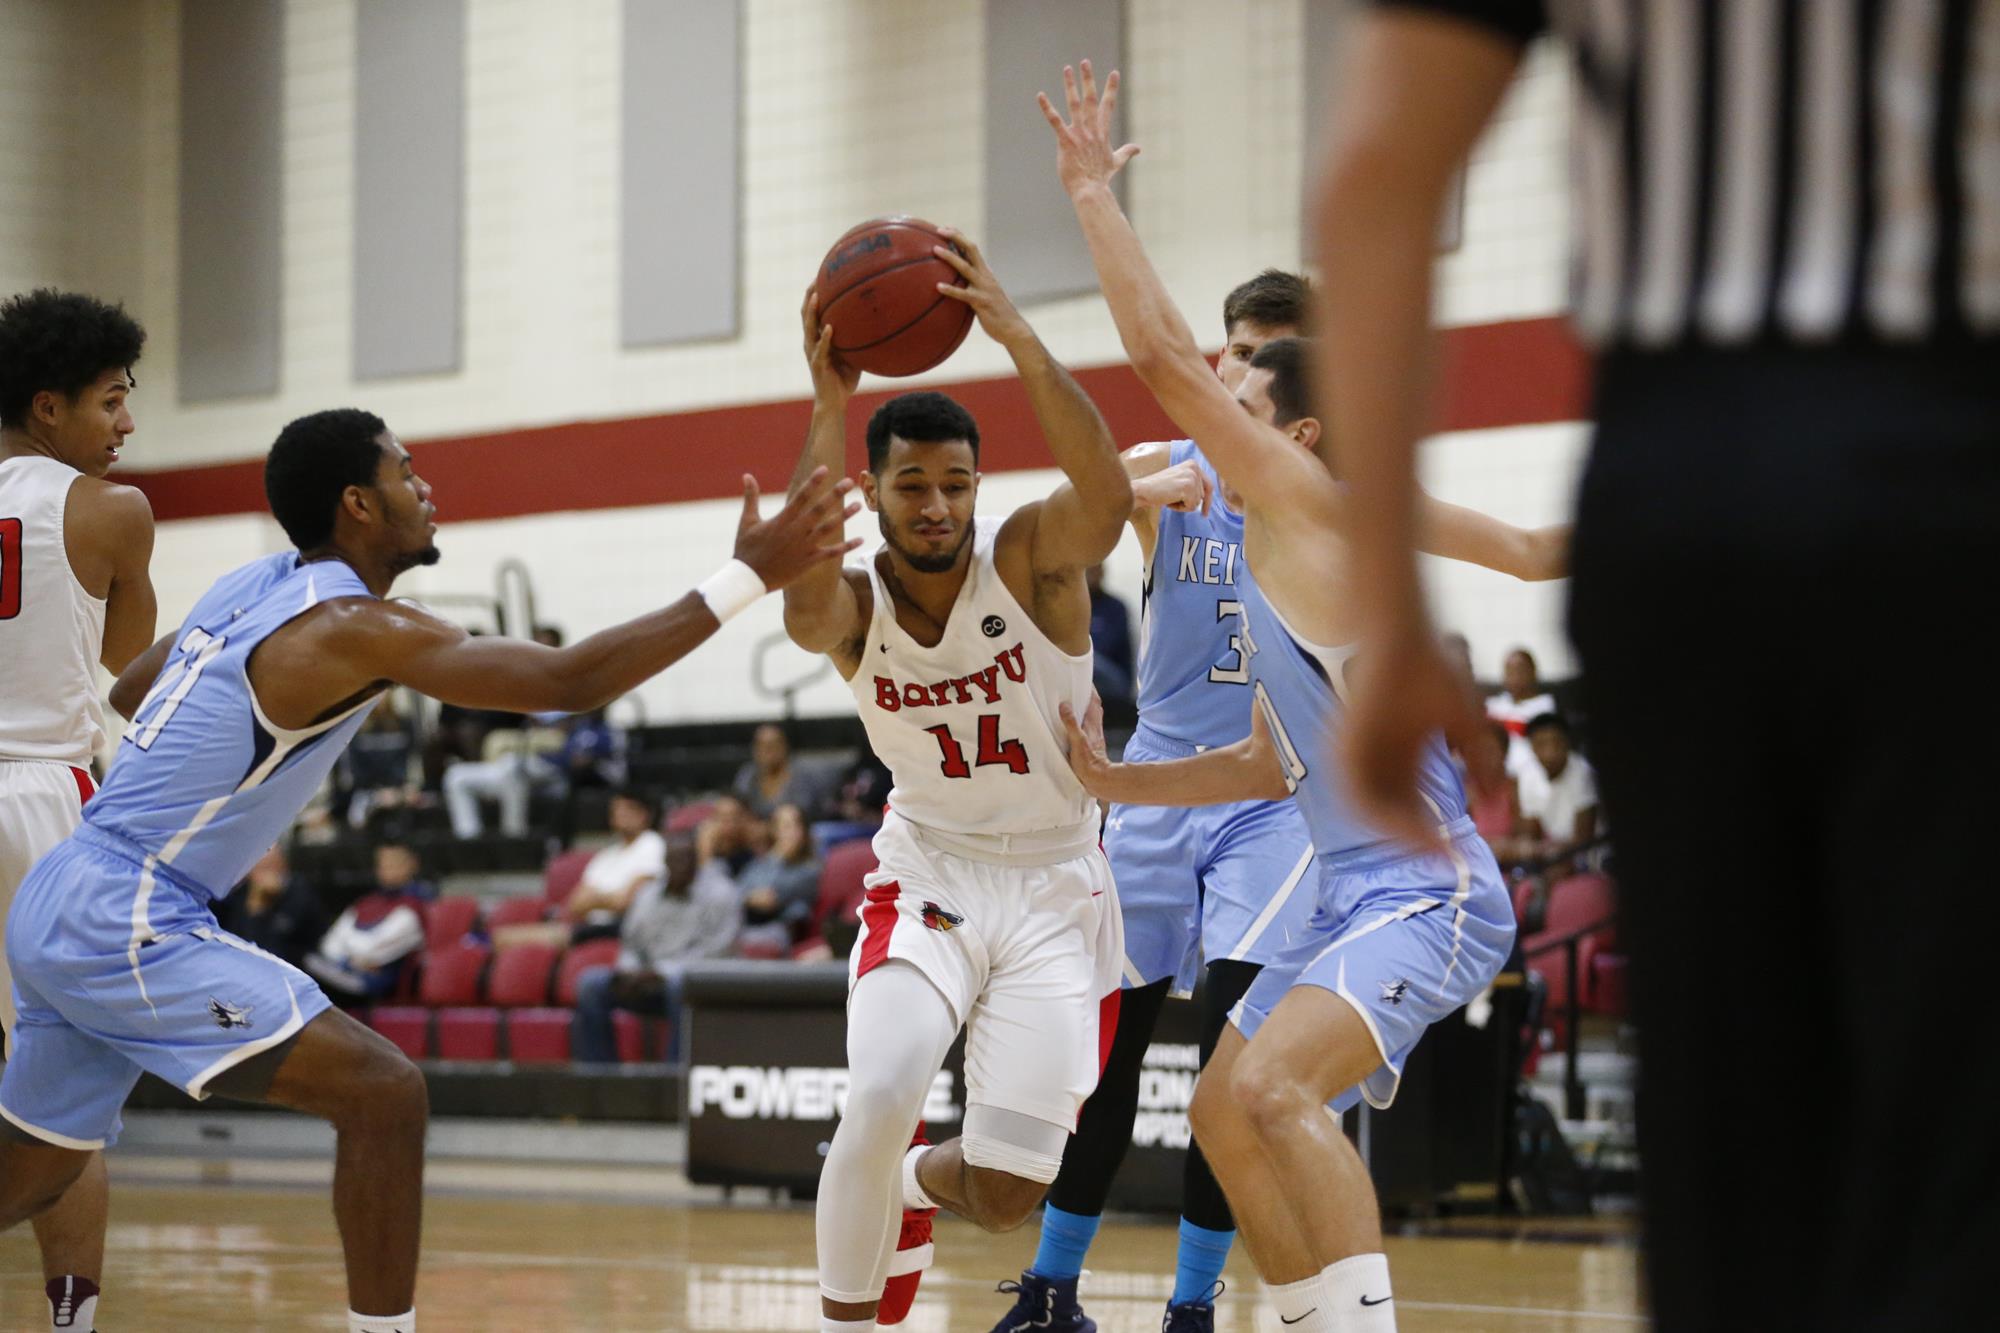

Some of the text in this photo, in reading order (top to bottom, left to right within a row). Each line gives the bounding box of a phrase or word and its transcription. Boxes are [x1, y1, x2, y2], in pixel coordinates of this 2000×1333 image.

[1176, 535, 1246, 586] KEI
[922, 713, 1031, 779] 14
[689, 1065, 956, 1123] POWERE
